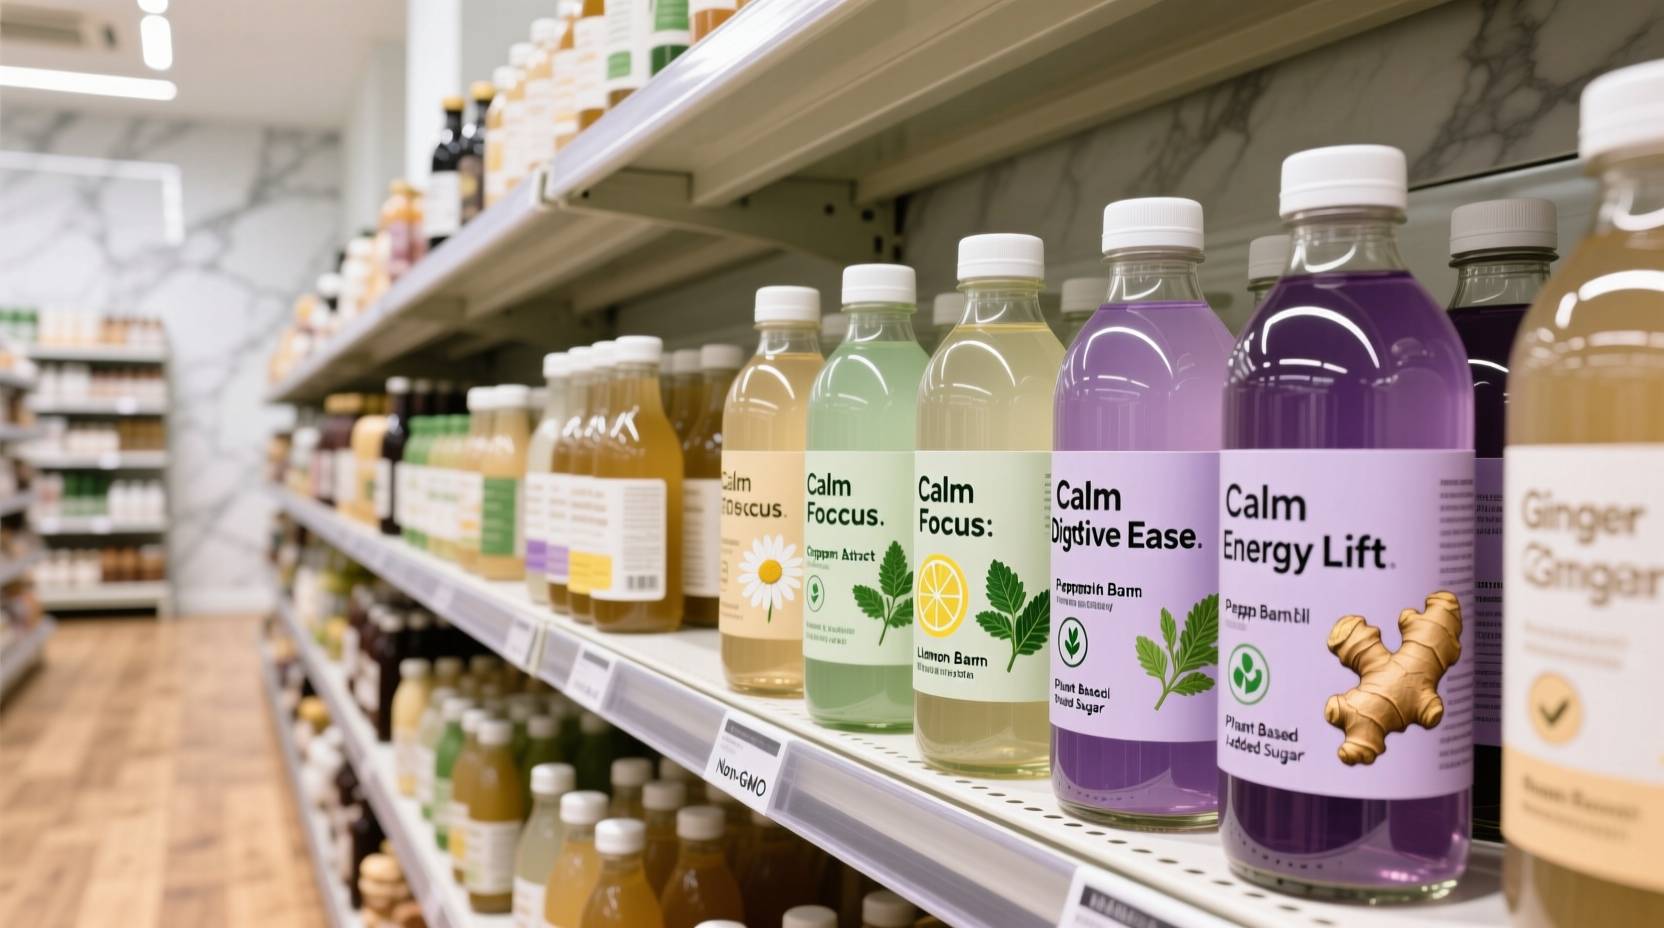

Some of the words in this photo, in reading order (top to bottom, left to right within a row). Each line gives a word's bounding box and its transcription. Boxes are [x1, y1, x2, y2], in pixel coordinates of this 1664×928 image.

[807, 472, 851, 496] Calm
[918, 475, 974, 503] Calm
[1056, 479, 1121, 511] Calm
[807, 501, 884, 526] Foccus.
[1226, 483, 1306, 522] Calm
[919, 508, 993, 537] Focus:
[1521, 488, 1646, 546] Ginger
[1128, 521, 1203, 549] Ease.
[1223, 530, 1314, 575] Energy
[1258, 722, 1298, 742] Based
[1264, 743, 1305, 765] Sugar
